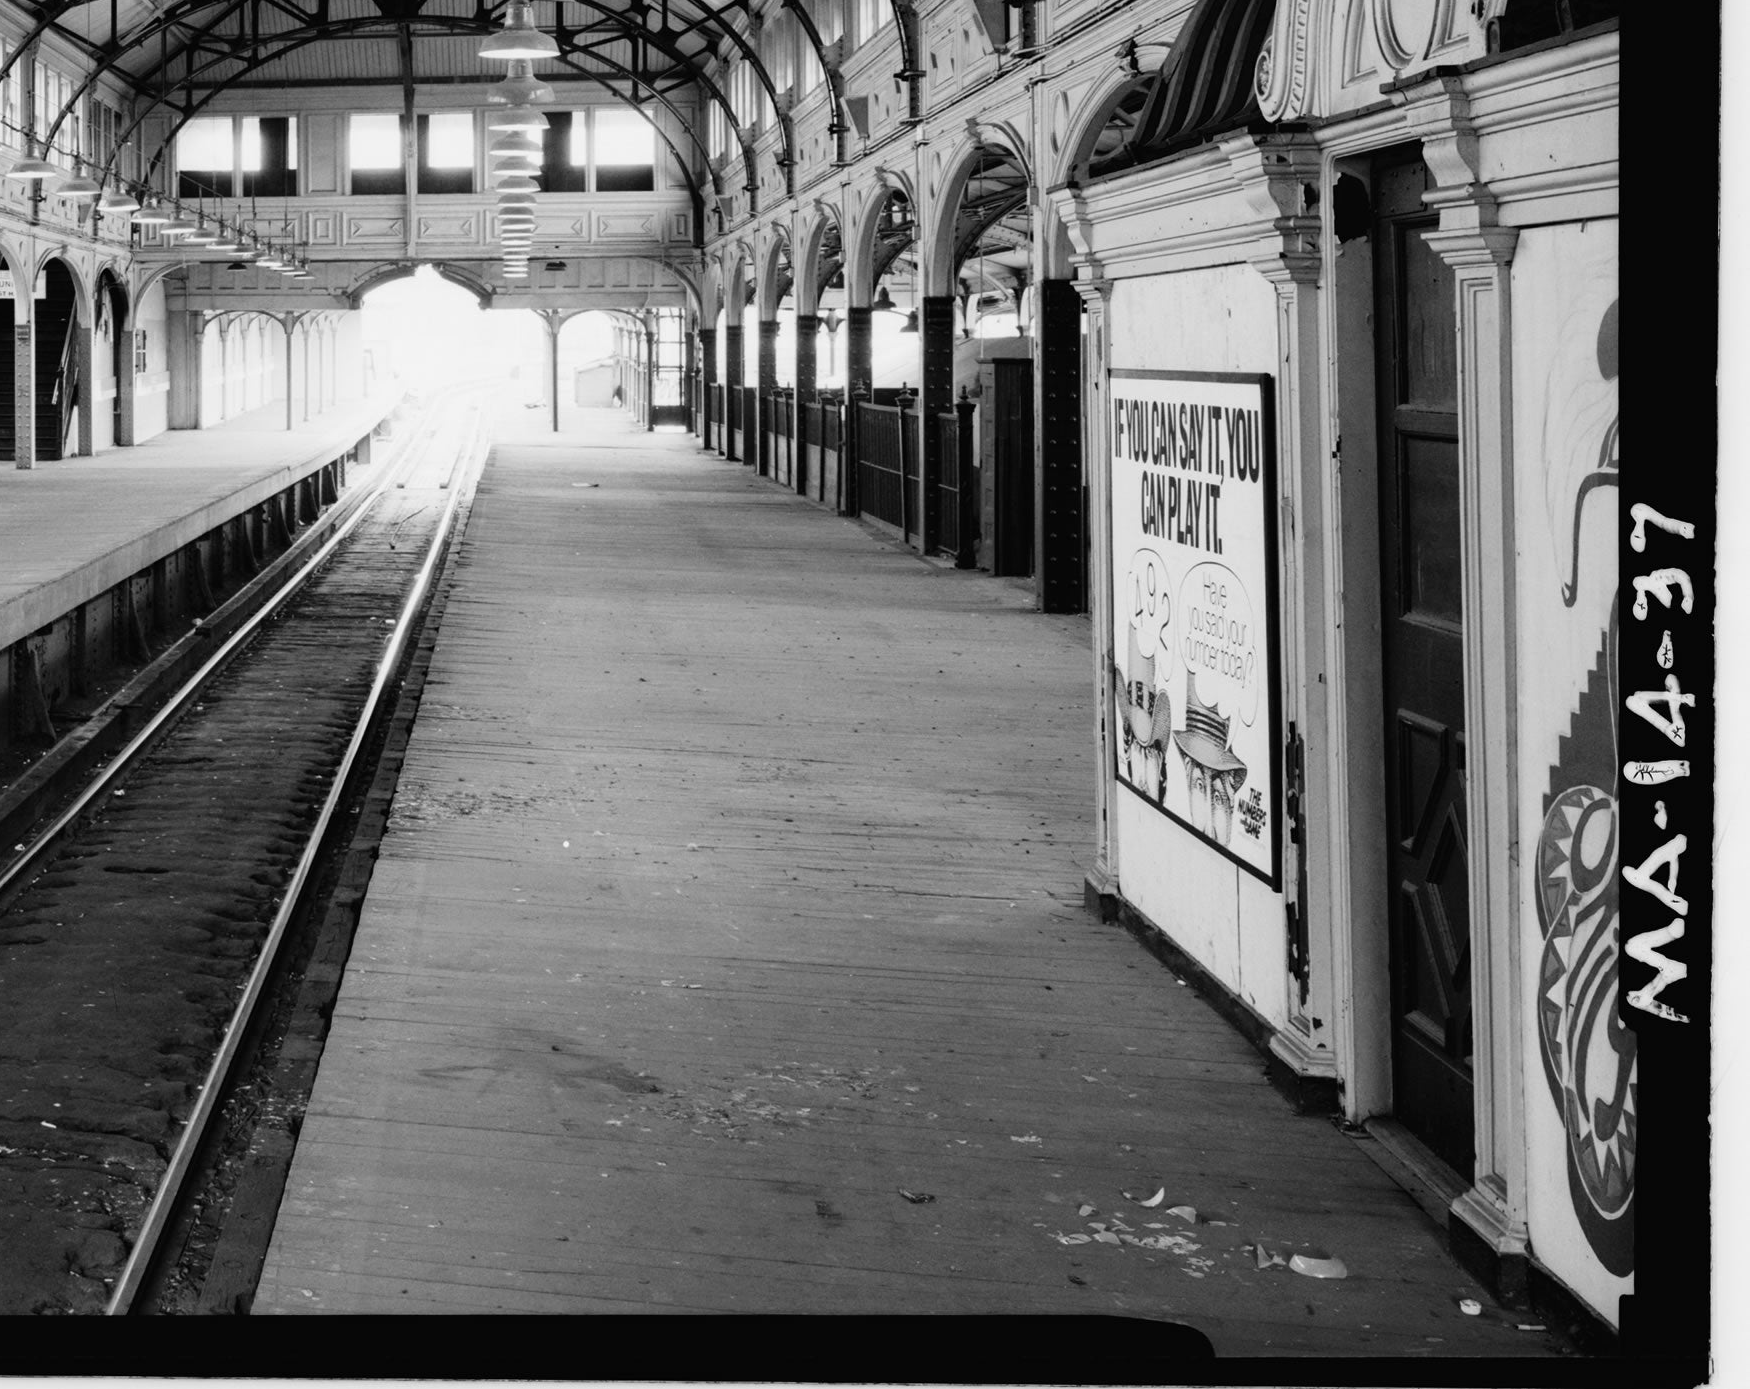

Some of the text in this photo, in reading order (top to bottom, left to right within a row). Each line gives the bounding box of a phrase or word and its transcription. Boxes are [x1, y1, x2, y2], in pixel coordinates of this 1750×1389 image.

[1114, 398, 1260, 486] IF YOU CAN SAY IT, YOU
[1141, 470, 1223, 555] CAN PLAY IT.
[1202, 571, 1227, 609] Have
[1238, 799, 1267, 827] NUMBERS
[1249, 788, 1262, 807] THE
